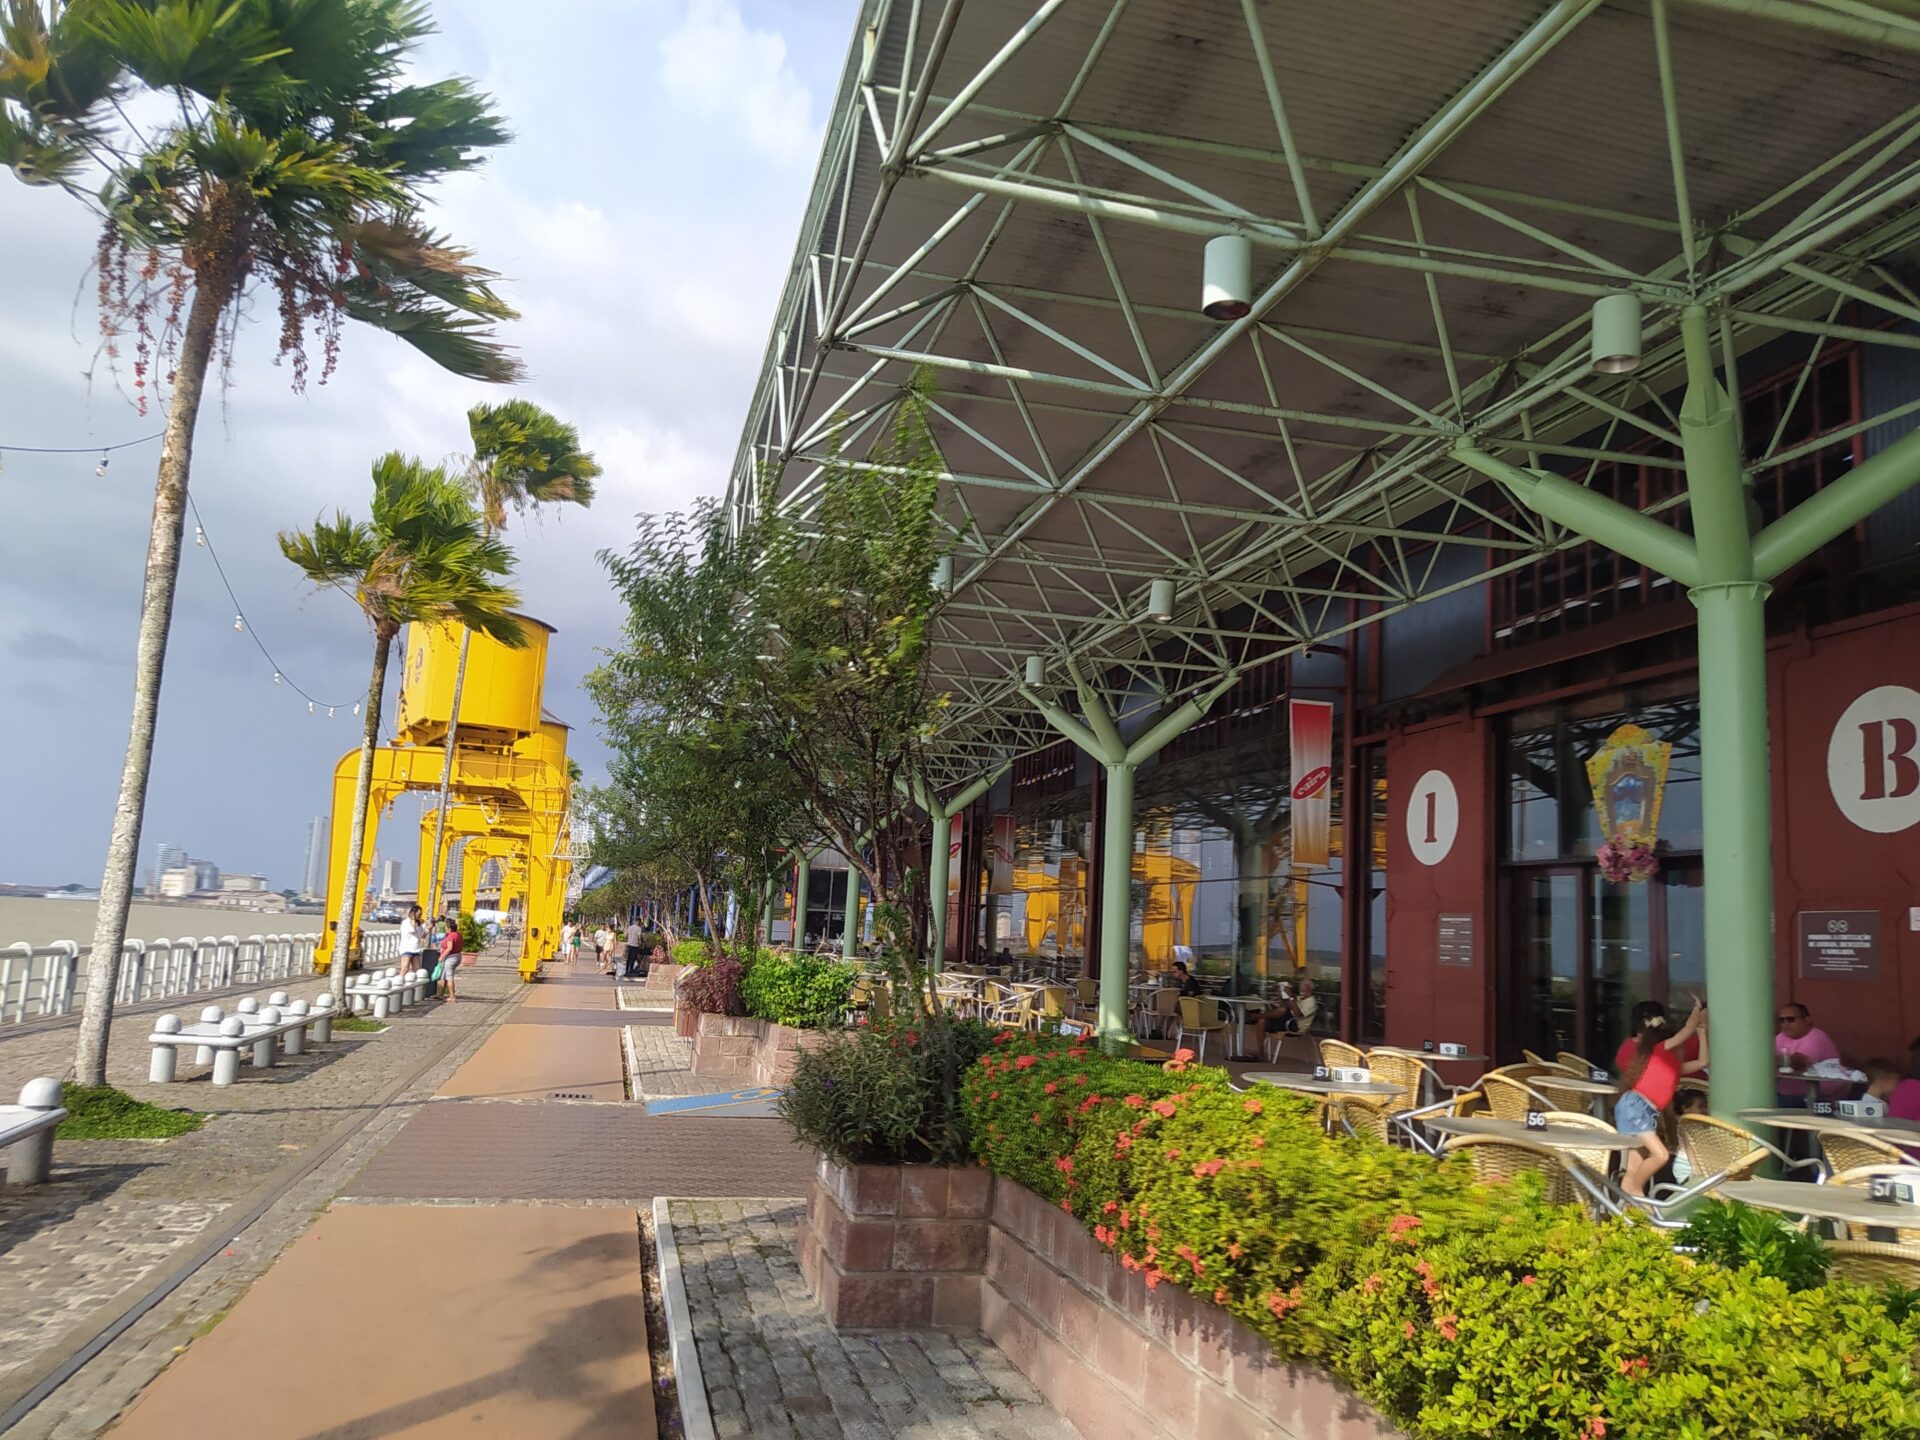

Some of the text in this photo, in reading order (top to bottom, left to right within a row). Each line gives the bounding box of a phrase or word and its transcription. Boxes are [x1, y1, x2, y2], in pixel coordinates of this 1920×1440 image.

[1858, 717, 1920, 800] B
[1592, 1070, 1609, 1081] 52
[1528, 1112, 1545, 1126] 56
